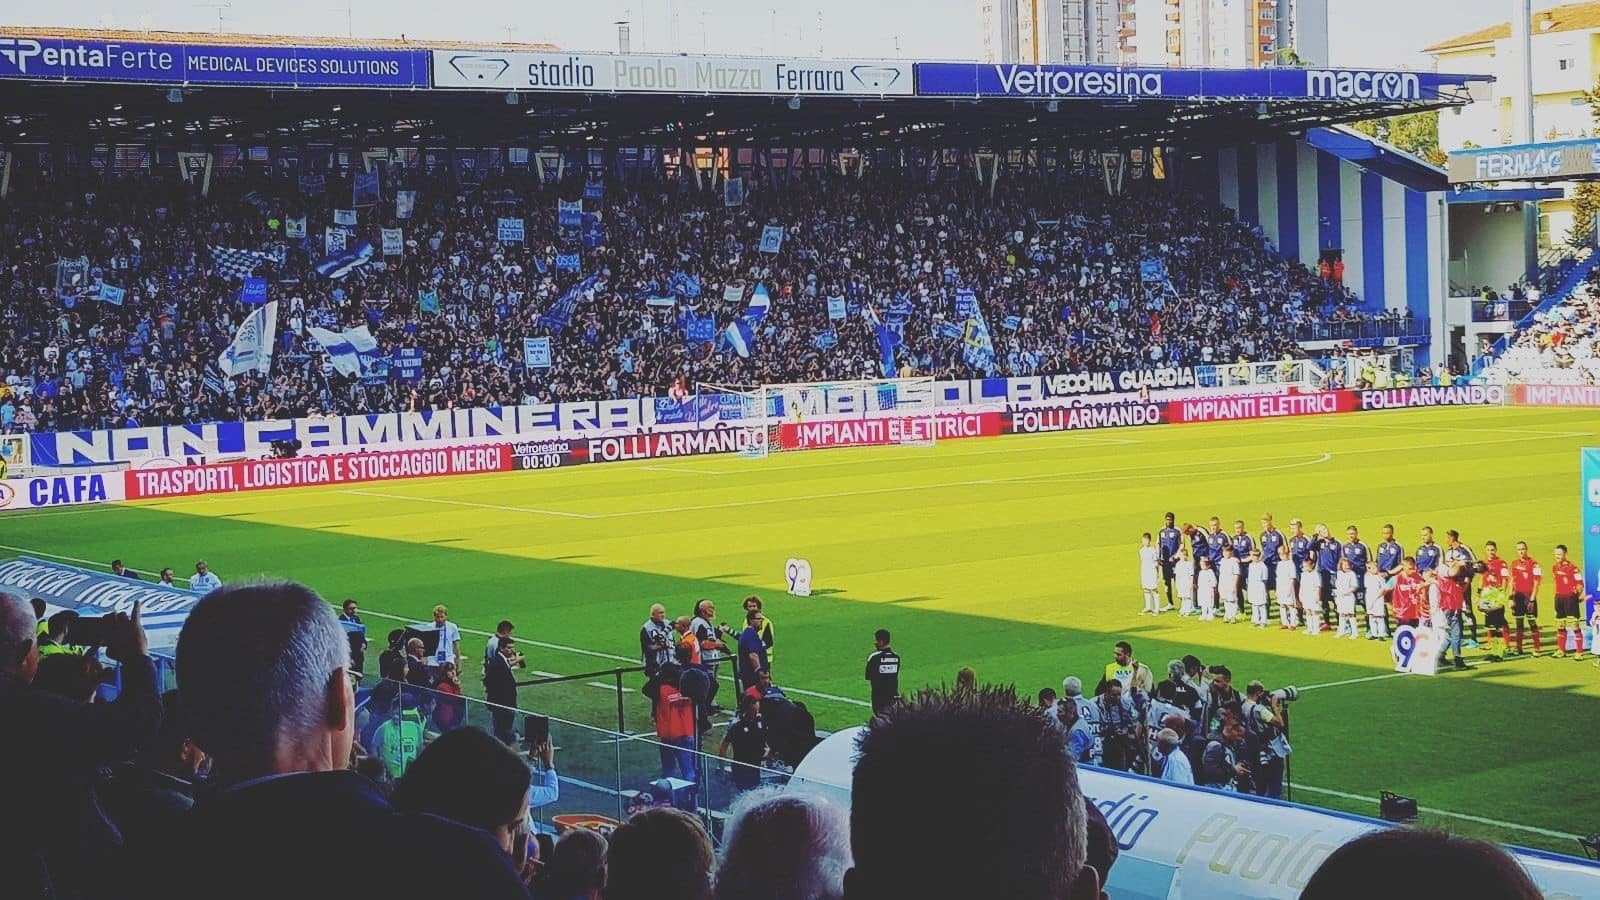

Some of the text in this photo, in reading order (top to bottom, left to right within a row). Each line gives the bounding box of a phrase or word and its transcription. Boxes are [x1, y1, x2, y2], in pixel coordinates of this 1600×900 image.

[18, 39, 173, 73] PentaFerte
[187, 55, 400, 76] MEDICAL DEVICES SOLUTIONS
[527, 57, 845, 92] stadio Paolo Mazza Ferrara
[995, 65, 1162, 95] Vetroresina
[1306, 69, 1420, 99] macron
[1046, 367, 1196, 397] VECCHIA GUARDIA
[1361, 384, 1502, 410] FOLLI ARMANDO
[1012, 409, 1064, 433] FOLLI
[1067, 403, 1161, 430] ARMANDO
[1183, 397, 1256, 422] IMPIANTI
[1259, 393, 1337, 417] ELETTRICI
[56, 424, 219, 464] NON
[588, 426, 766, 464] FOLLI ARMANDO
[796, 415, 981, 449] IMPIANTI ELETTRICI
[513, 442, 569, 454] Vetroresina
[522, 453, 561, 470] 00:00
[136, 447, 502, 497] TRASPORTI, LOGISTICA E STOCCAGGIO MERCI
[29, 474, 107, 506] CAFA
[1097, 792, 1159, 851] dio
